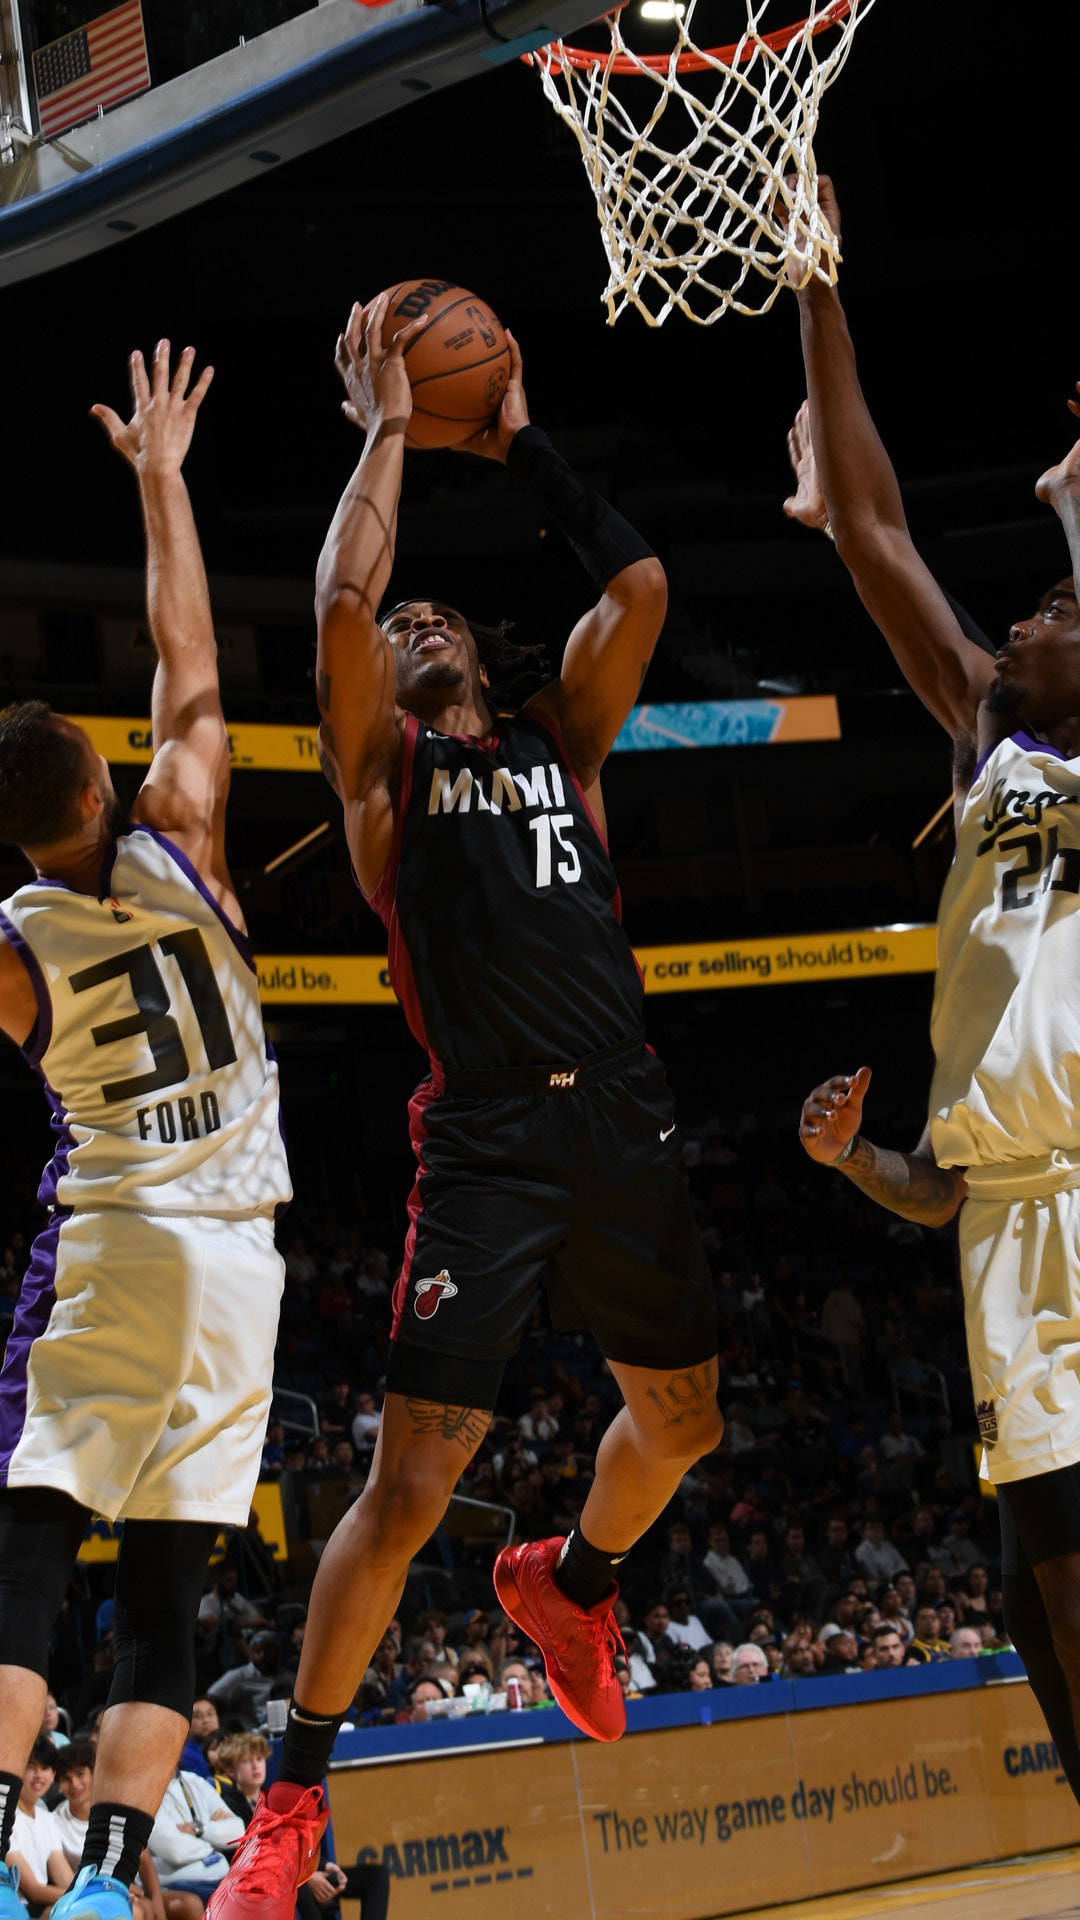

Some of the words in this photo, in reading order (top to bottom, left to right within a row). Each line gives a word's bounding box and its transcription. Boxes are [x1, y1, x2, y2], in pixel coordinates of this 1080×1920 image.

[428, 763, 565, 815] MIAMI
[529, 814, 582, 888] 15
[302, 966, 337, 990] be.
[654, 960, 692, 979] car
[698, 952, 771, 977] selling
[776, 942, 854, 969] should
[858, 940, 895, 964] be.
[69, 927, 237, 1103] 31
[136, 1091, 221, 1143] FORD
[593, 1809, 648, 1852] The
[655, 1806, 708, 1845] way
[715, 1793, 786, 1842] game
[791, 1780, 836, 1823] day
[842, 1763, 919, 1812] should
[922, 1761, 958, 1797] be.
